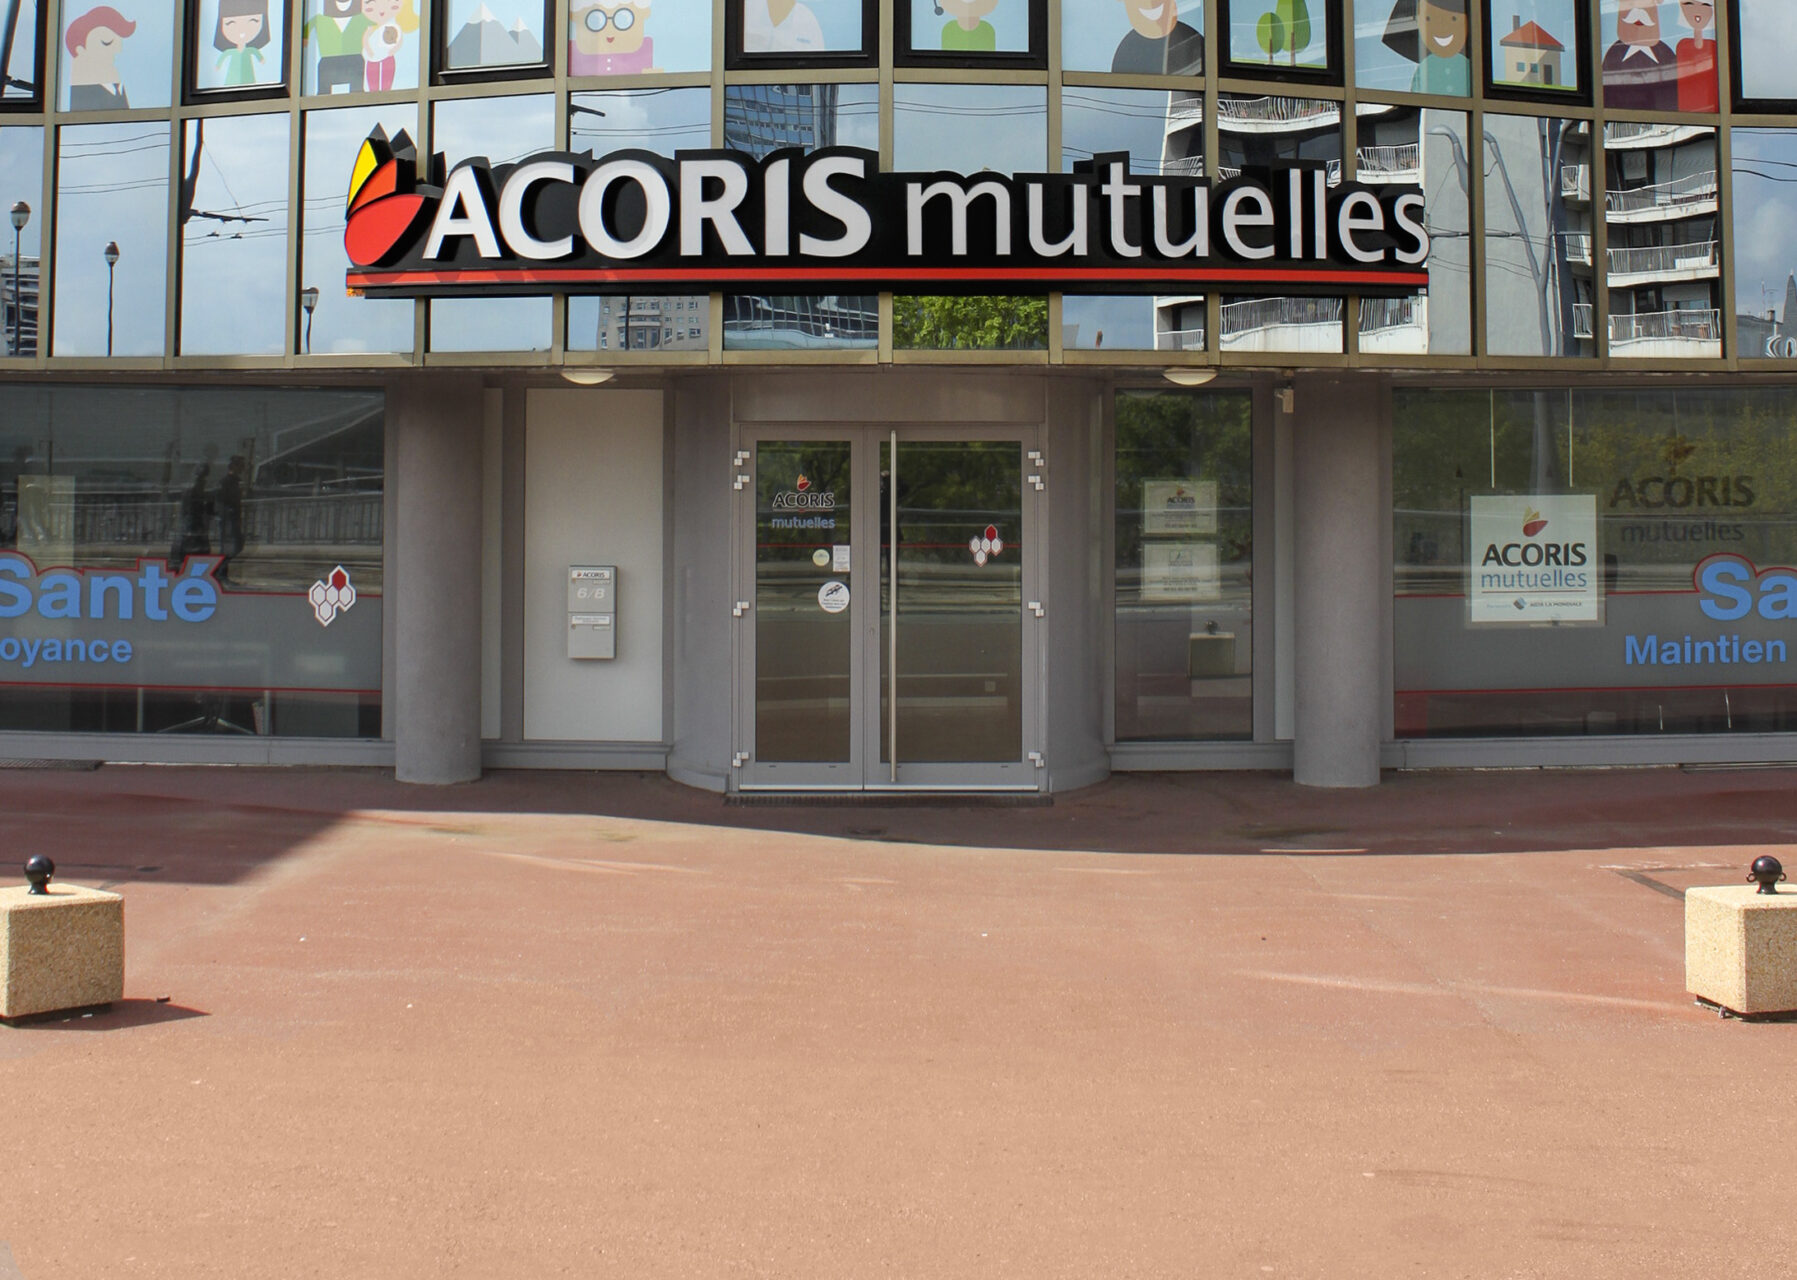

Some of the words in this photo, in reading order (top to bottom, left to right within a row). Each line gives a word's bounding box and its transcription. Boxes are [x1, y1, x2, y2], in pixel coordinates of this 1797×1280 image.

[422, 157, 872, 260] ACORIS
[906, 161, 1431, 264] mutuelles
[772, 492, 835, 508] ACORIS
[1610, 475, 1756, 508] ACORIS
[771, 516, 835, 529] mutuelles
[1621, 521, 1745, 542] mutuelles
[1481, 543, 1587, 568] ACORIS
[0, 558, 217, 622] Santé
[1481, 569, 1587, 588] mutuelles
[1700, 561, 1797, 620] Sa
[0, 637, 133, 668] oyance
[1625, 635, 1787, 665] Maintien
